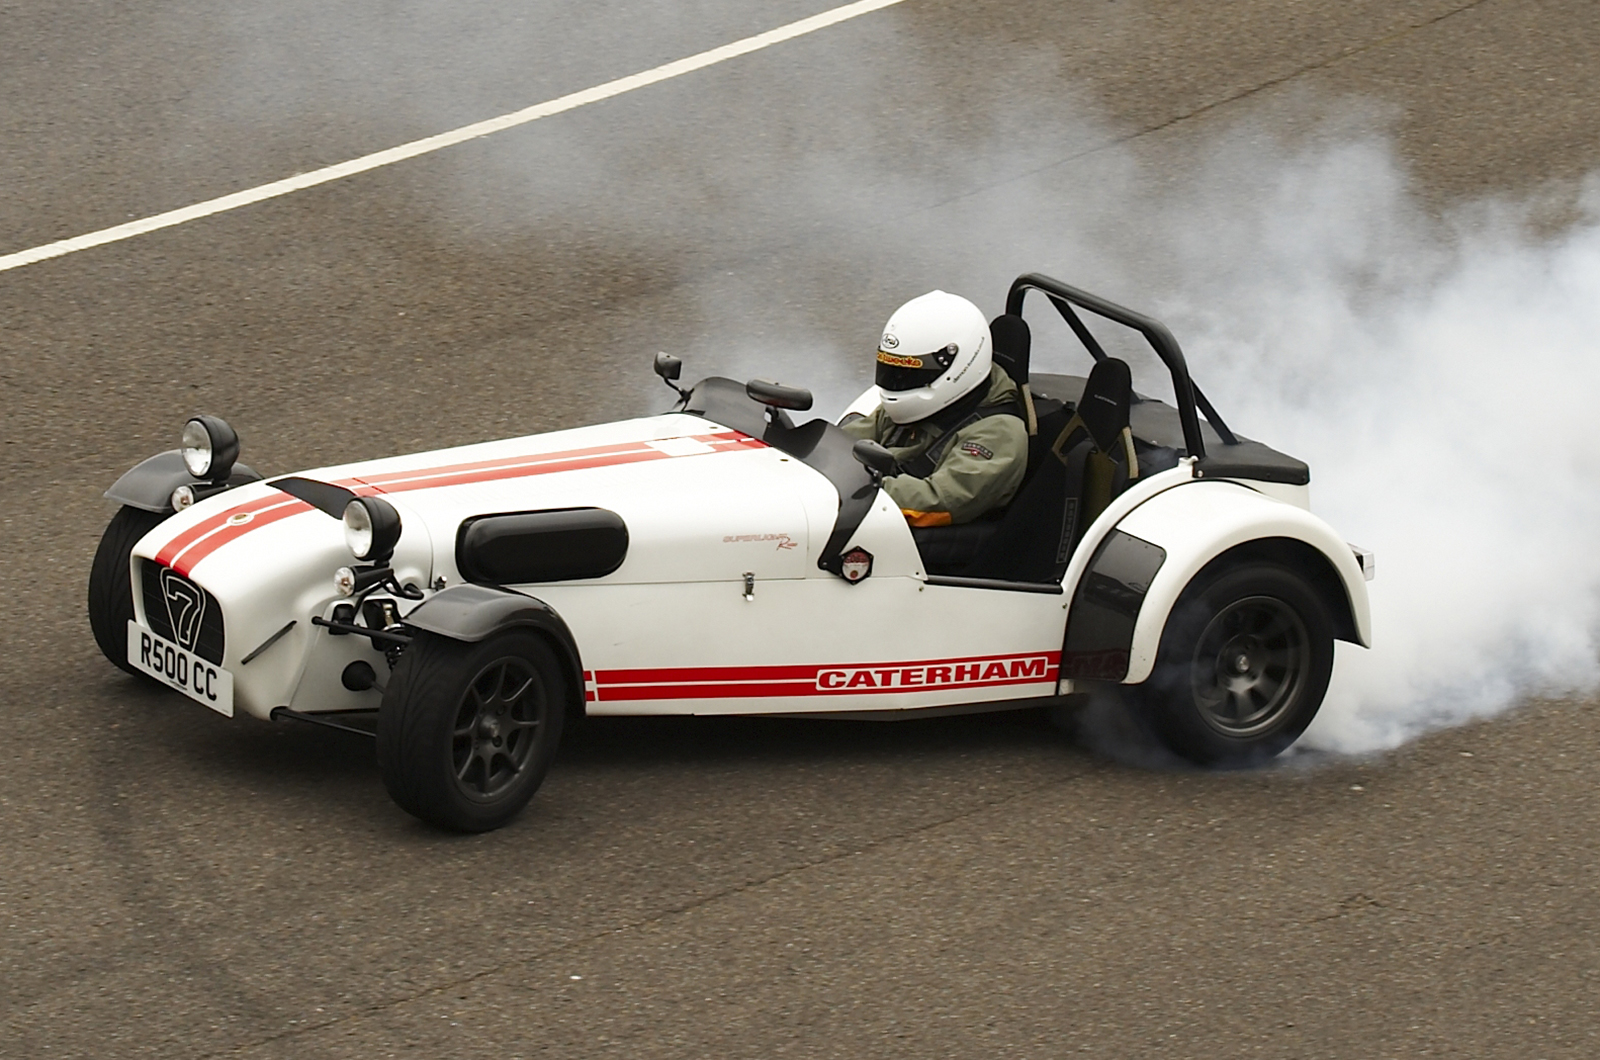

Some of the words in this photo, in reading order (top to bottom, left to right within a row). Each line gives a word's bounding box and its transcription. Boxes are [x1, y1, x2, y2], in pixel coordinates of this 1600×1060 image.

[165, 575, 201, 645] 7
[141, 631, 188, 686] R500
[193, 660, 217, 702] CC
[817, 659, 1046, 689] CATERHAM
